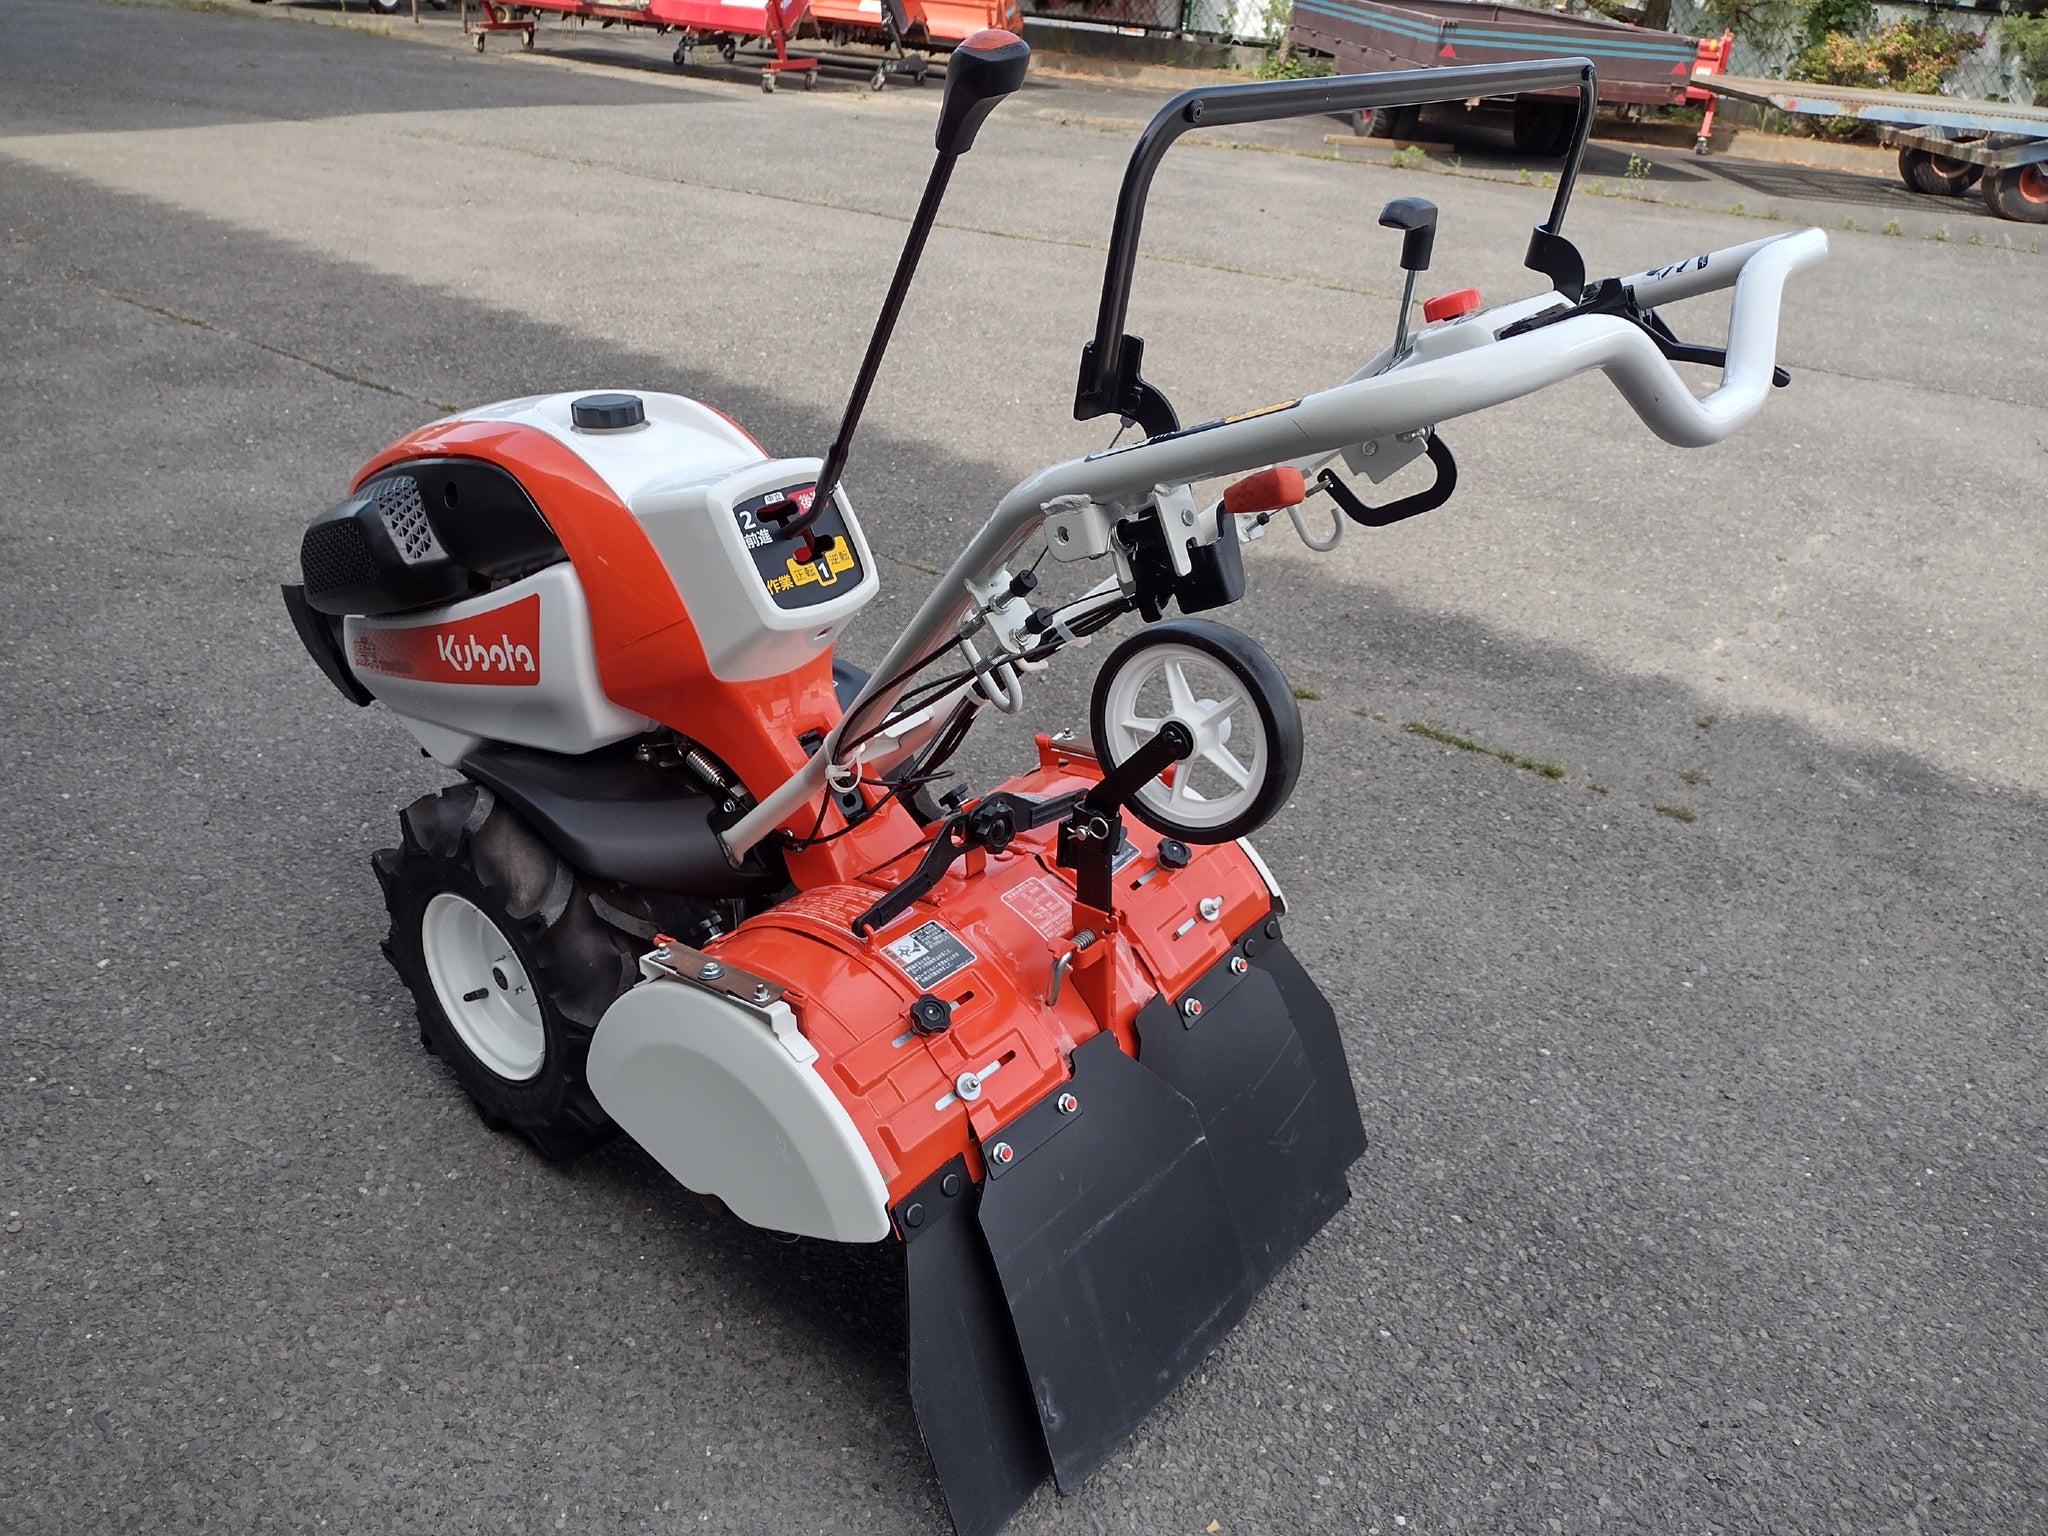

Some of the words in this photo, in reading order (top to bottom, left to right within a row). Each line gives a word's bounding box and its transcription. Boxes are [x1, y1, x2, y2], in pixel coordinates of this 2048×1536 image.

[766, 493, 783, 502] 中立
[739, 511, 757, 529] 2
[744, 529, 773, 549] 前進
[829, 551, 850, 565] 逆転
[794, 566, 816, 581] 正転
[818, 562, 830, 578] 1
[766, 574, 794, 595] 作業
[437, 633, 536, 672] Kubota
